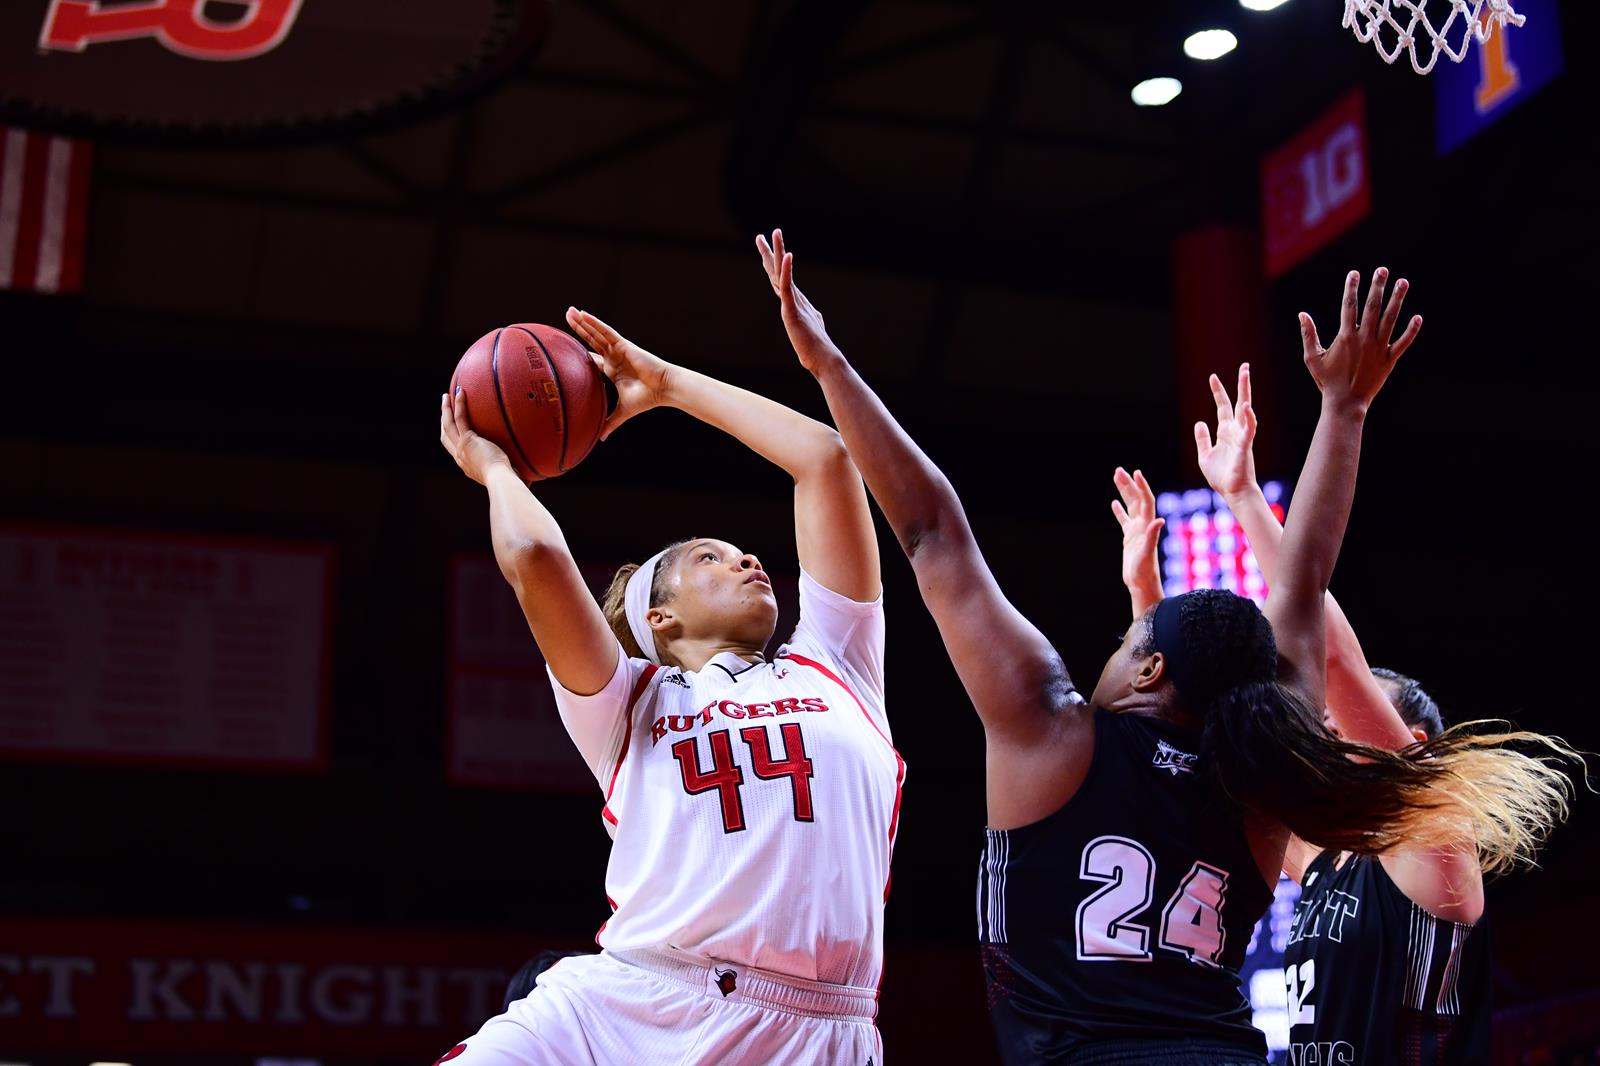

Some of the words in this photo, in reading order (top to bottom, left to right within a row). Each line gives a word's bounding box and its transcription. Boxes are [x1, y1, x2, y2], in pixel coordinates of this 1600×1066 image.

[661, 678, 691, 689] adidas
[651, 697, 829, 748] RUTGERS
[671, 722, 814, 834] 44
[1152, 749, 1198, 768] NEC
[1074, 834, 1230, 968] 24
